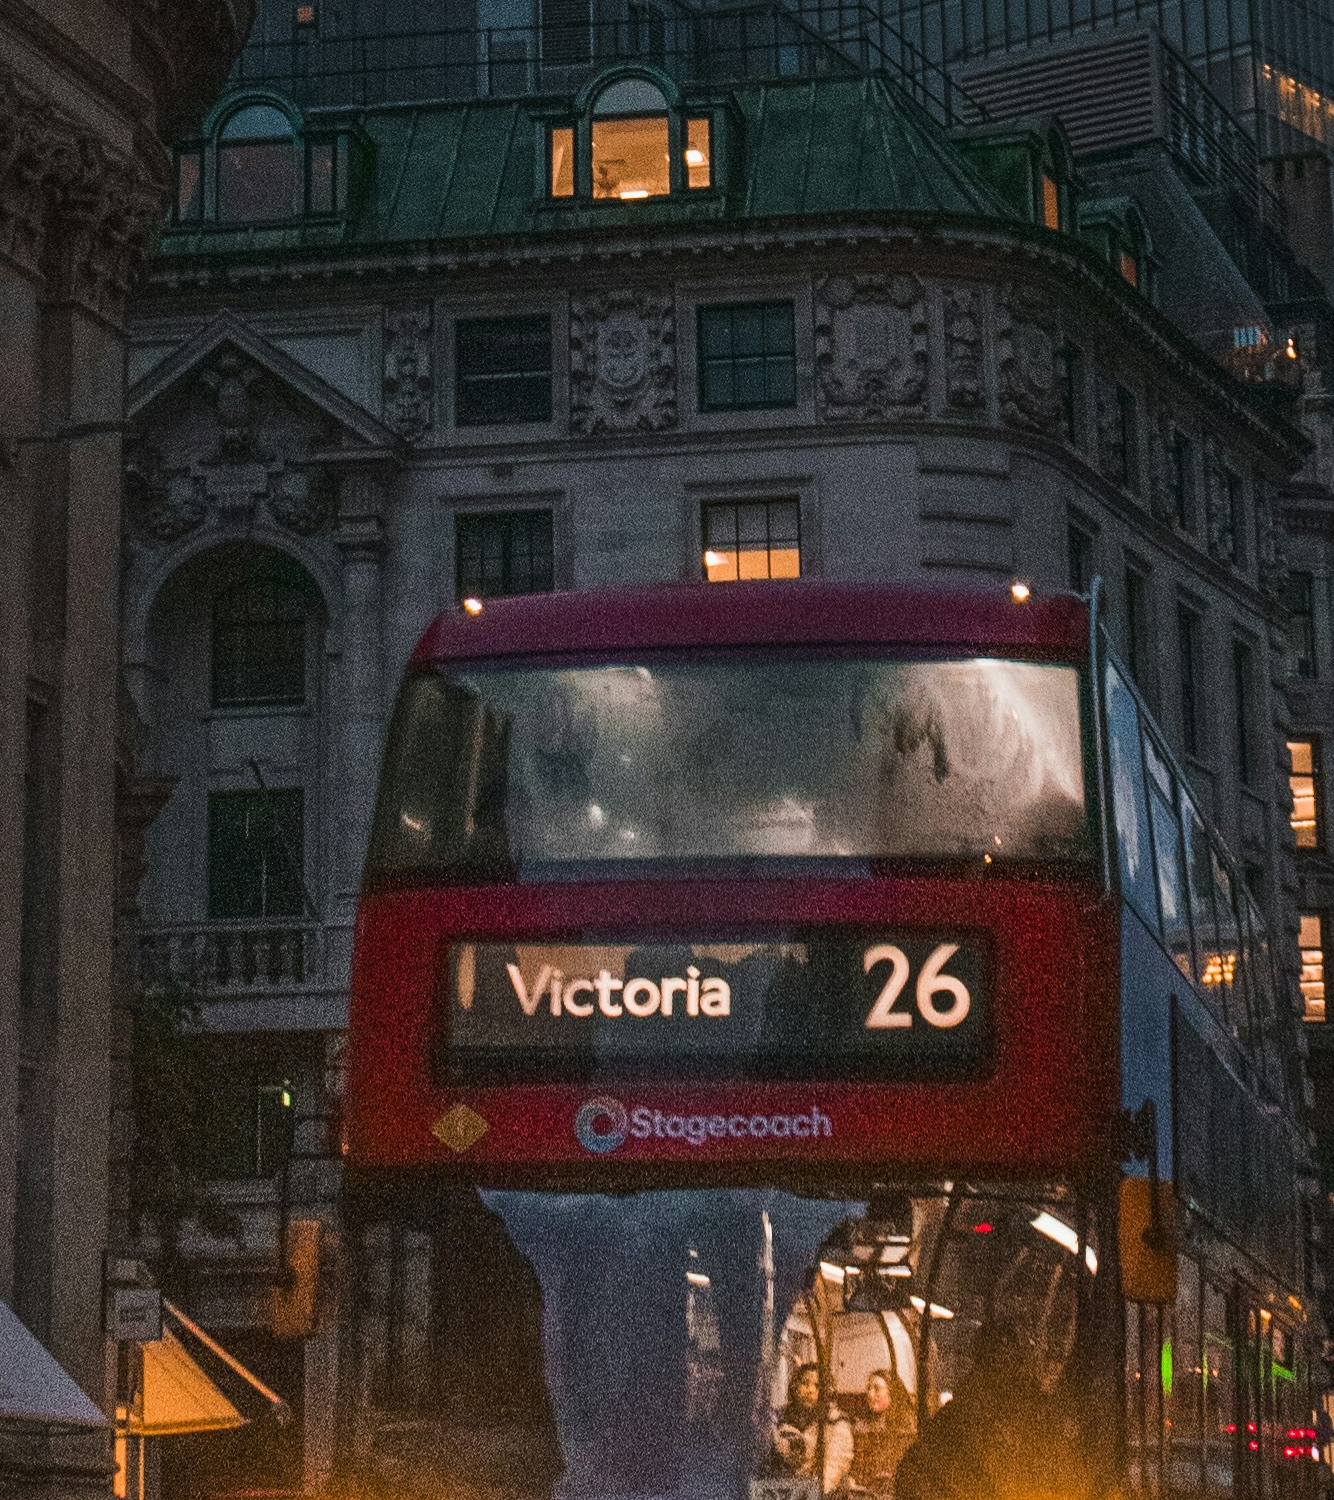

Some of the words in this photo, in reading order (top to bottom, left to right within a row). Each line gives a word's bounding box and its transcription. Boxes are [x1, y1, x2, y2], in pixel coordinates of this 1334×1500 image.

[504, 963, 732, 1018] Victoria
[863, 942, 971, 1031] 26
[630, 1105, 834, 1146] Stagecoach
